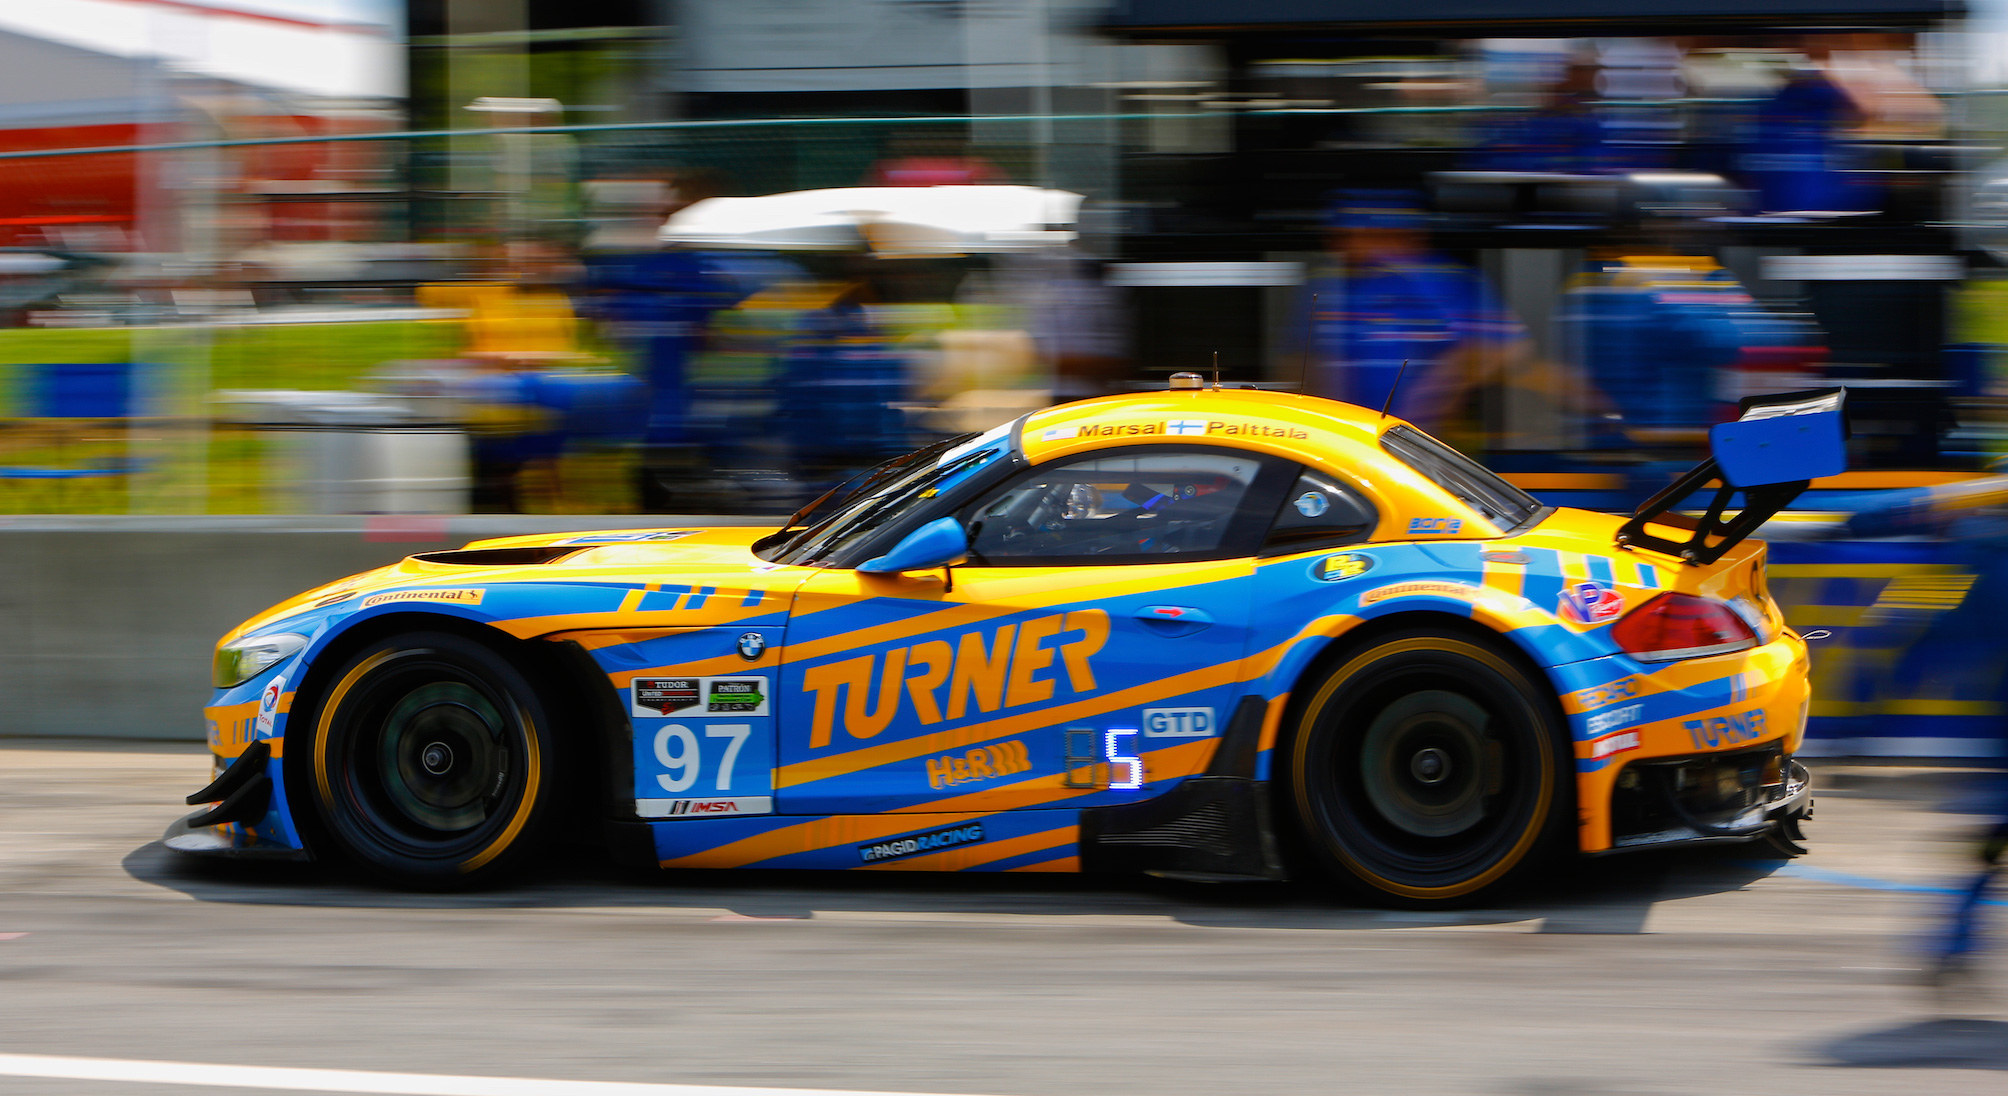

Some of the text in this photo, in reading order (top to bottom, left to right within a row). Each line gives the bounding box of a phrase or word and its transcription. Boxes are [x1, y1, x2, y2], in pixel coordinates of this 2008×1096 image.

[1078, 421, 1309, 440] Marsal Palttala
[364, 590, 464, 606] Continental
[654, 681, 690, 689] TUDOR
[802, 608, 1111, 750] TURNER
[1150, 711, 1208, 733] GTD
[1682, 708, 1769, 750] TURNER
[653, 724, 752, 793] 97
[1105, 729, 1143, 790] 5
[690, 801, 740, 813] IMSA
